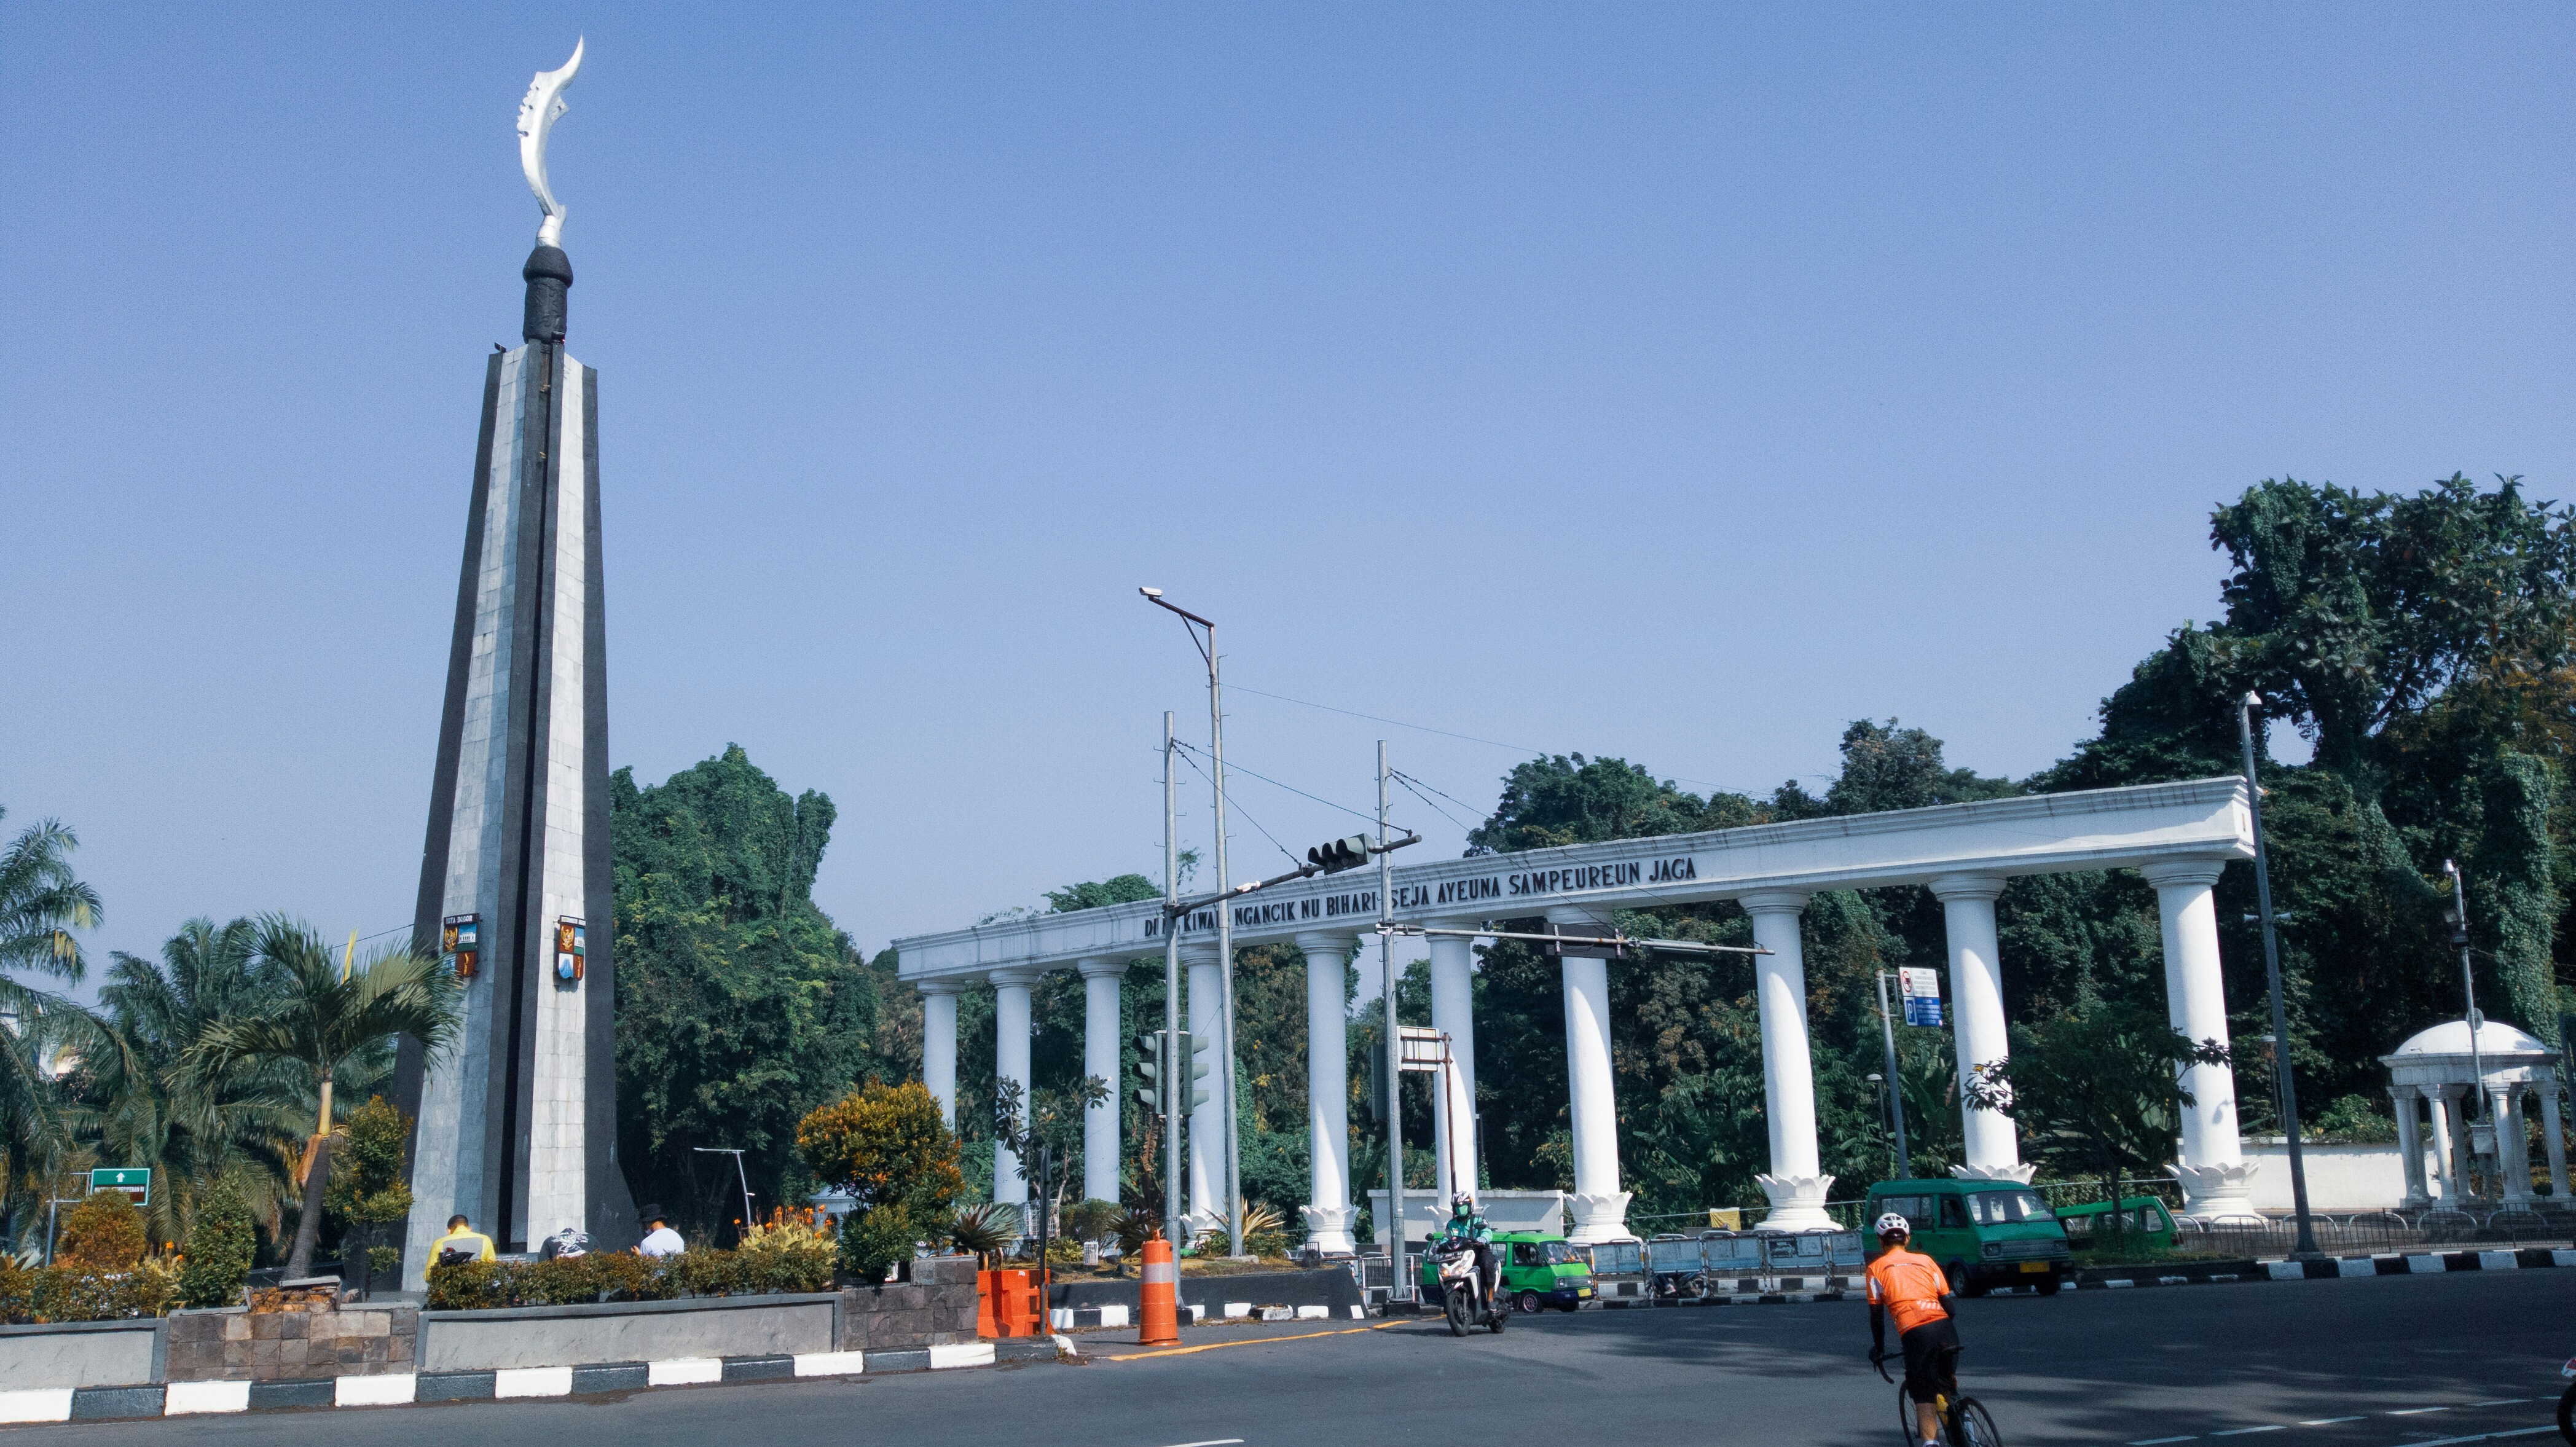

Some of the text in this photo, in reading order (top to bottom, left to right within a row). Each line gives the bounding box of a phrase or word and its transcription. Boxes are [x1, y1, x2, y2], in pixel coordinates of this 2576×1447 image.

[1184, 911, 1219, 931] KIWA
[1235, 901, 1295, 926] NGANCIK
[1301, 898, 1319, 919] NU
[1326, 892, 1376, 916] BIHARI
[1391, 885, 1429, 908] SEJA
[1437, 877, 1501, 903] AYEUNA
[1509, 861, 1640, 895] SAMPEUREUN
[1649, 857, 1697, 881] JAGA
